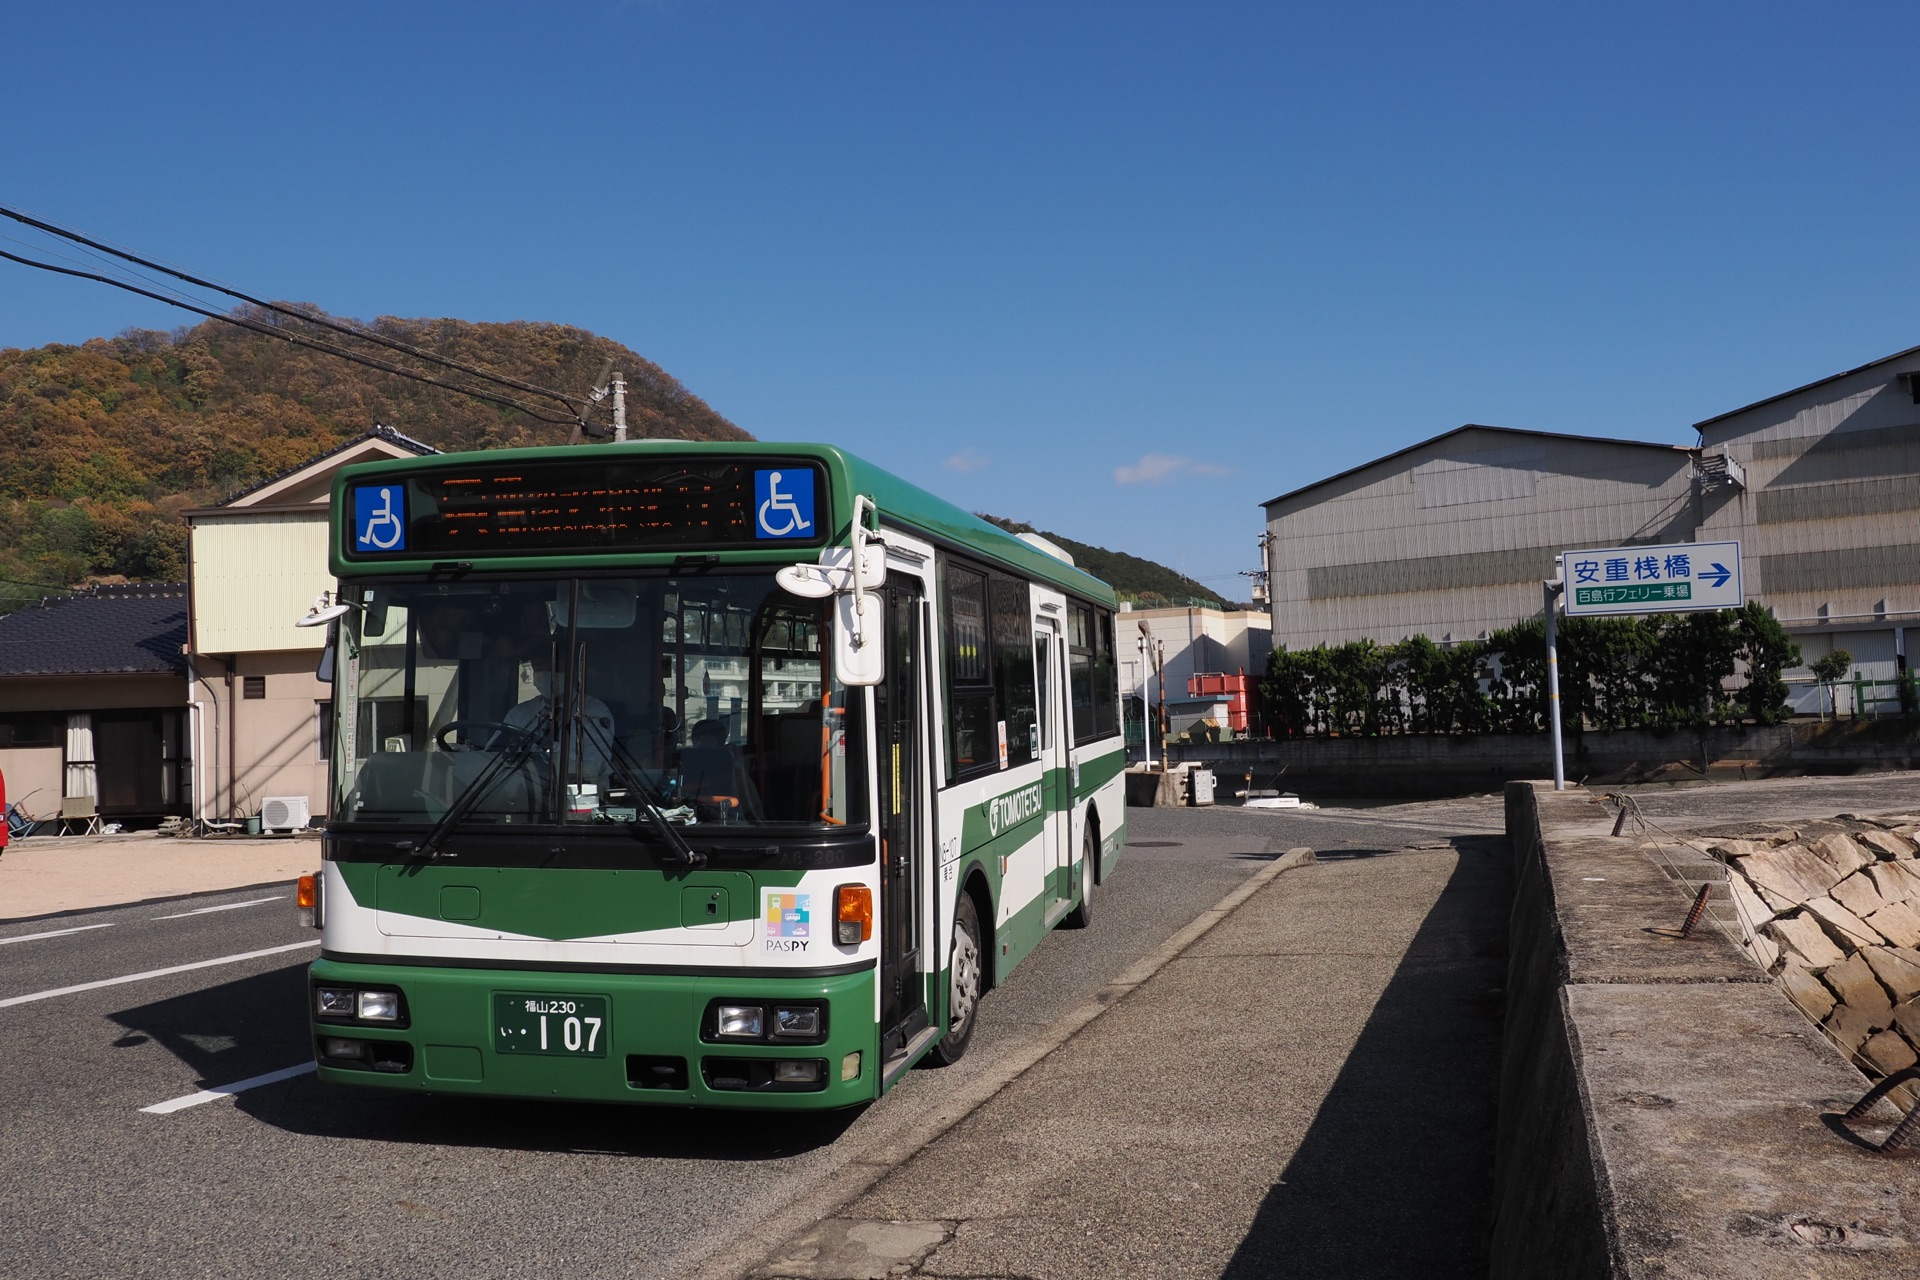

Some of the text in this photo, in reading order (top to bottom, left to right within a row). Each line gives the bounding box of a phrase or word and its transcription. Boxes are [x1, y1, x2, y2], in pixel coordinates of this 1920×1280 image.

[1574, 554, 1691, 584] 安重桟橋
[1578, 585, 1689, 603] 百島行フェリー乗場
[998, 783, 1042, 829] TOMOTETSU
[766, 940, 810, 952] PASPY
